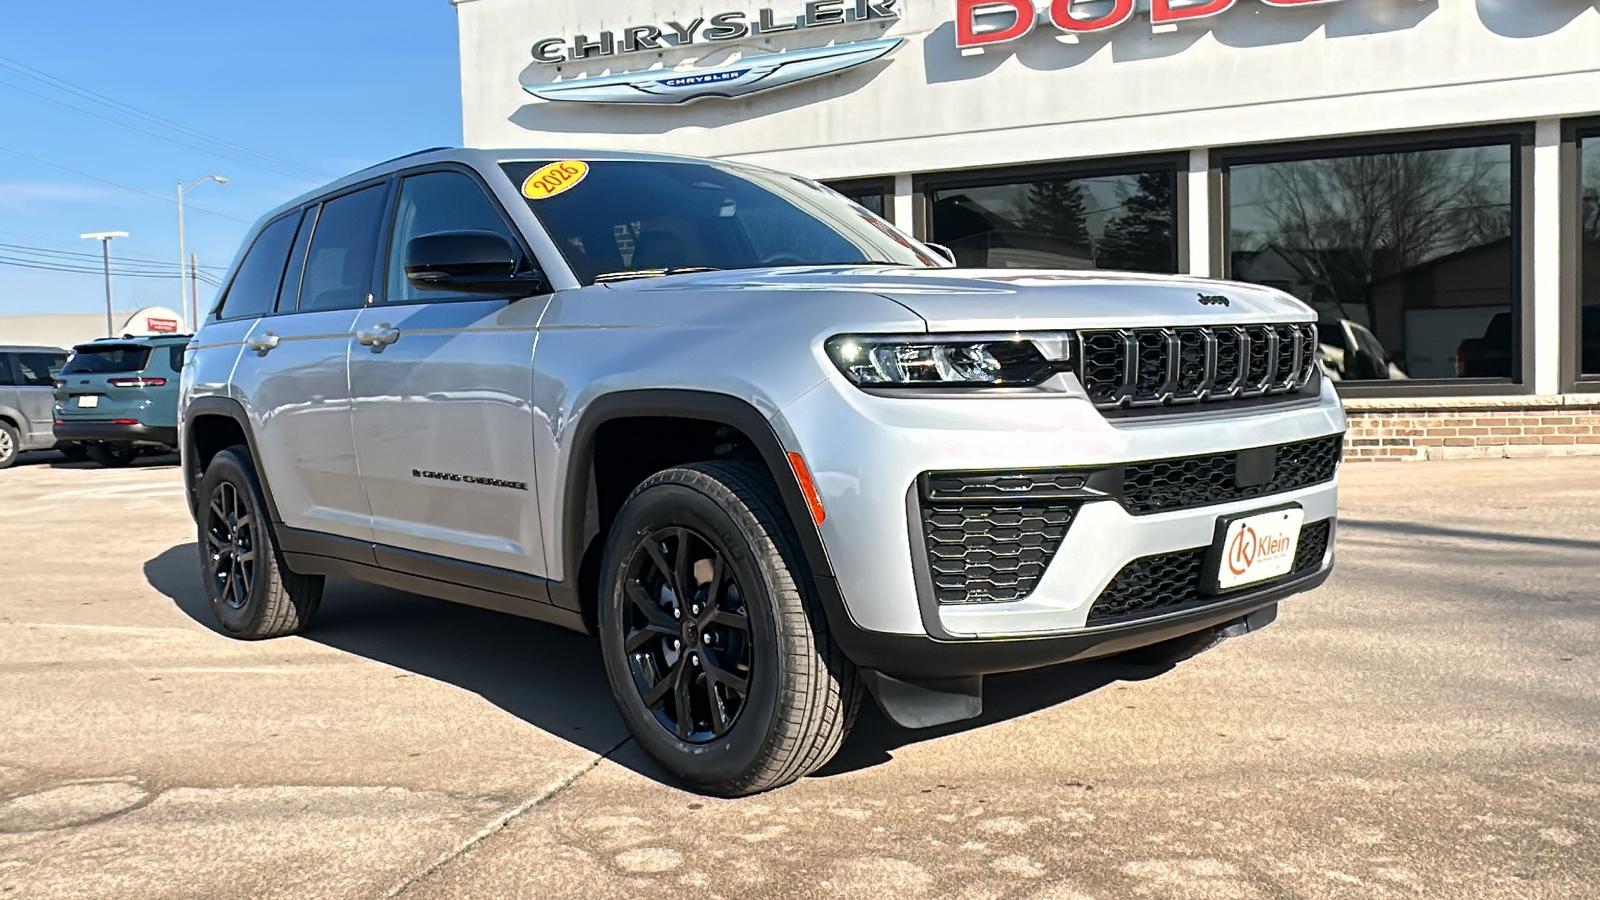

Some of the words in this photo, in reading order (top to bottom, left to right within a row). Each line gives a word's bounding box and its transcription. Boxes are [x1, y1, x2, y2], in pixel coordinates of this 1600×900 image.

[531, 0, 898, 64] CHRYSLER
[666, 72, 739, 86] CHRYSLER
[533, 163, 579, 193] 2026
[1197, 293, 1230, 307] Jeep
[1257, 532, 1290, 557] Klein
